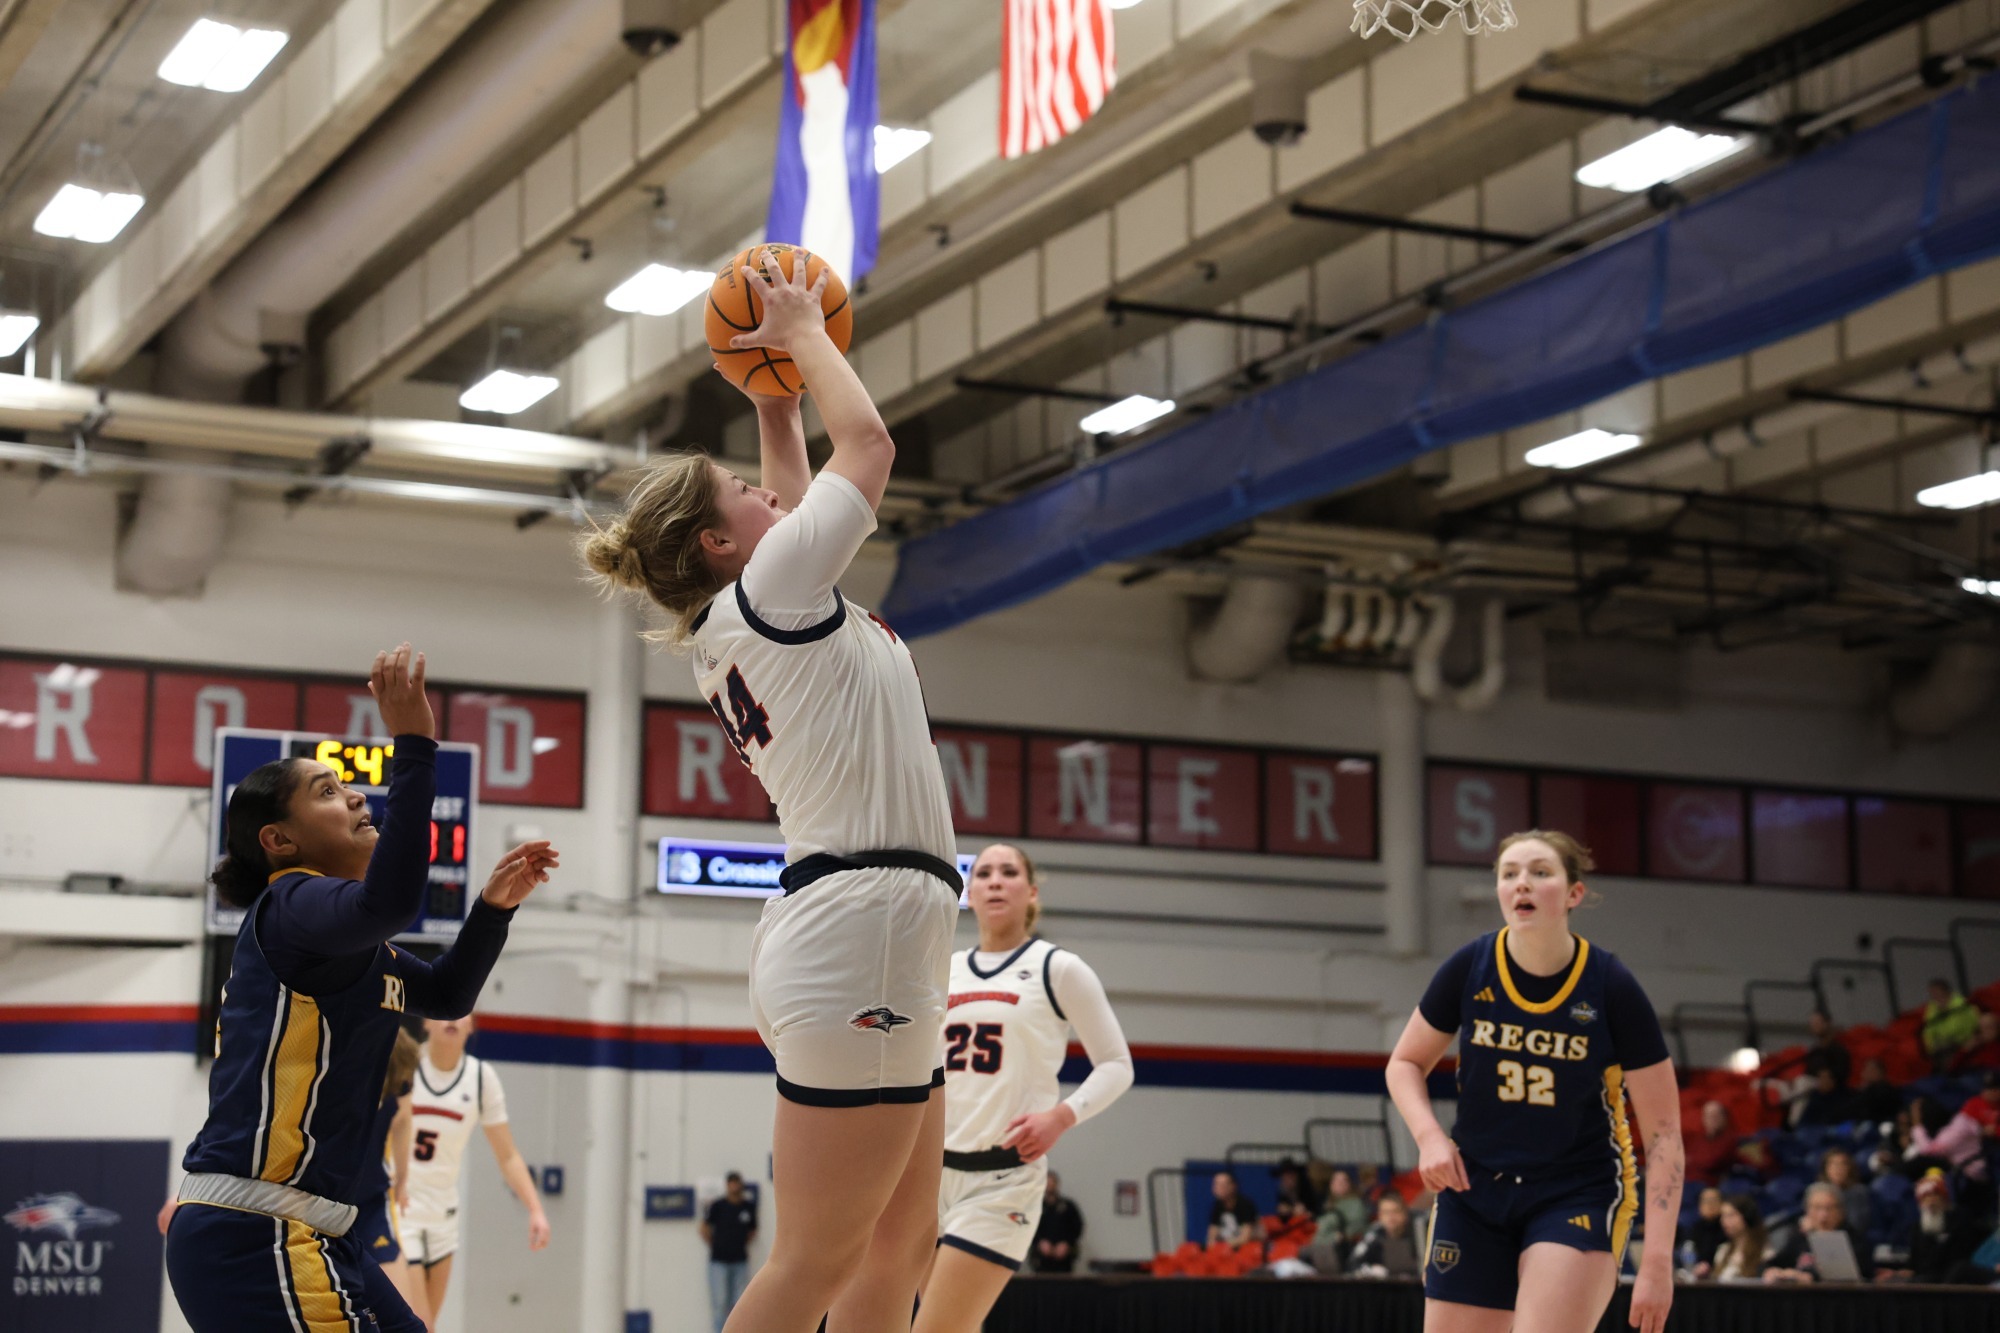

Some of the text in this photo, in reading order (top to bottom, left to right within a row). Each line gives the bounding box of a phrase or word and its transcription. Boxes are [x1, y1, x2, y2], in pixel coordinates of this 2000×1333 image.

[709, 662, 774, 770] 14
[944, 1022, 1004, 1075] 25
[1470, 1019, 1589, 1061] REGIS
[1496, 1059, 1556, 1107] 32
[413, 1129, 440, 1162] 5
[16, 1240, 104, 1275] MSU
[12, 1275, 103, 1296] DENVER
